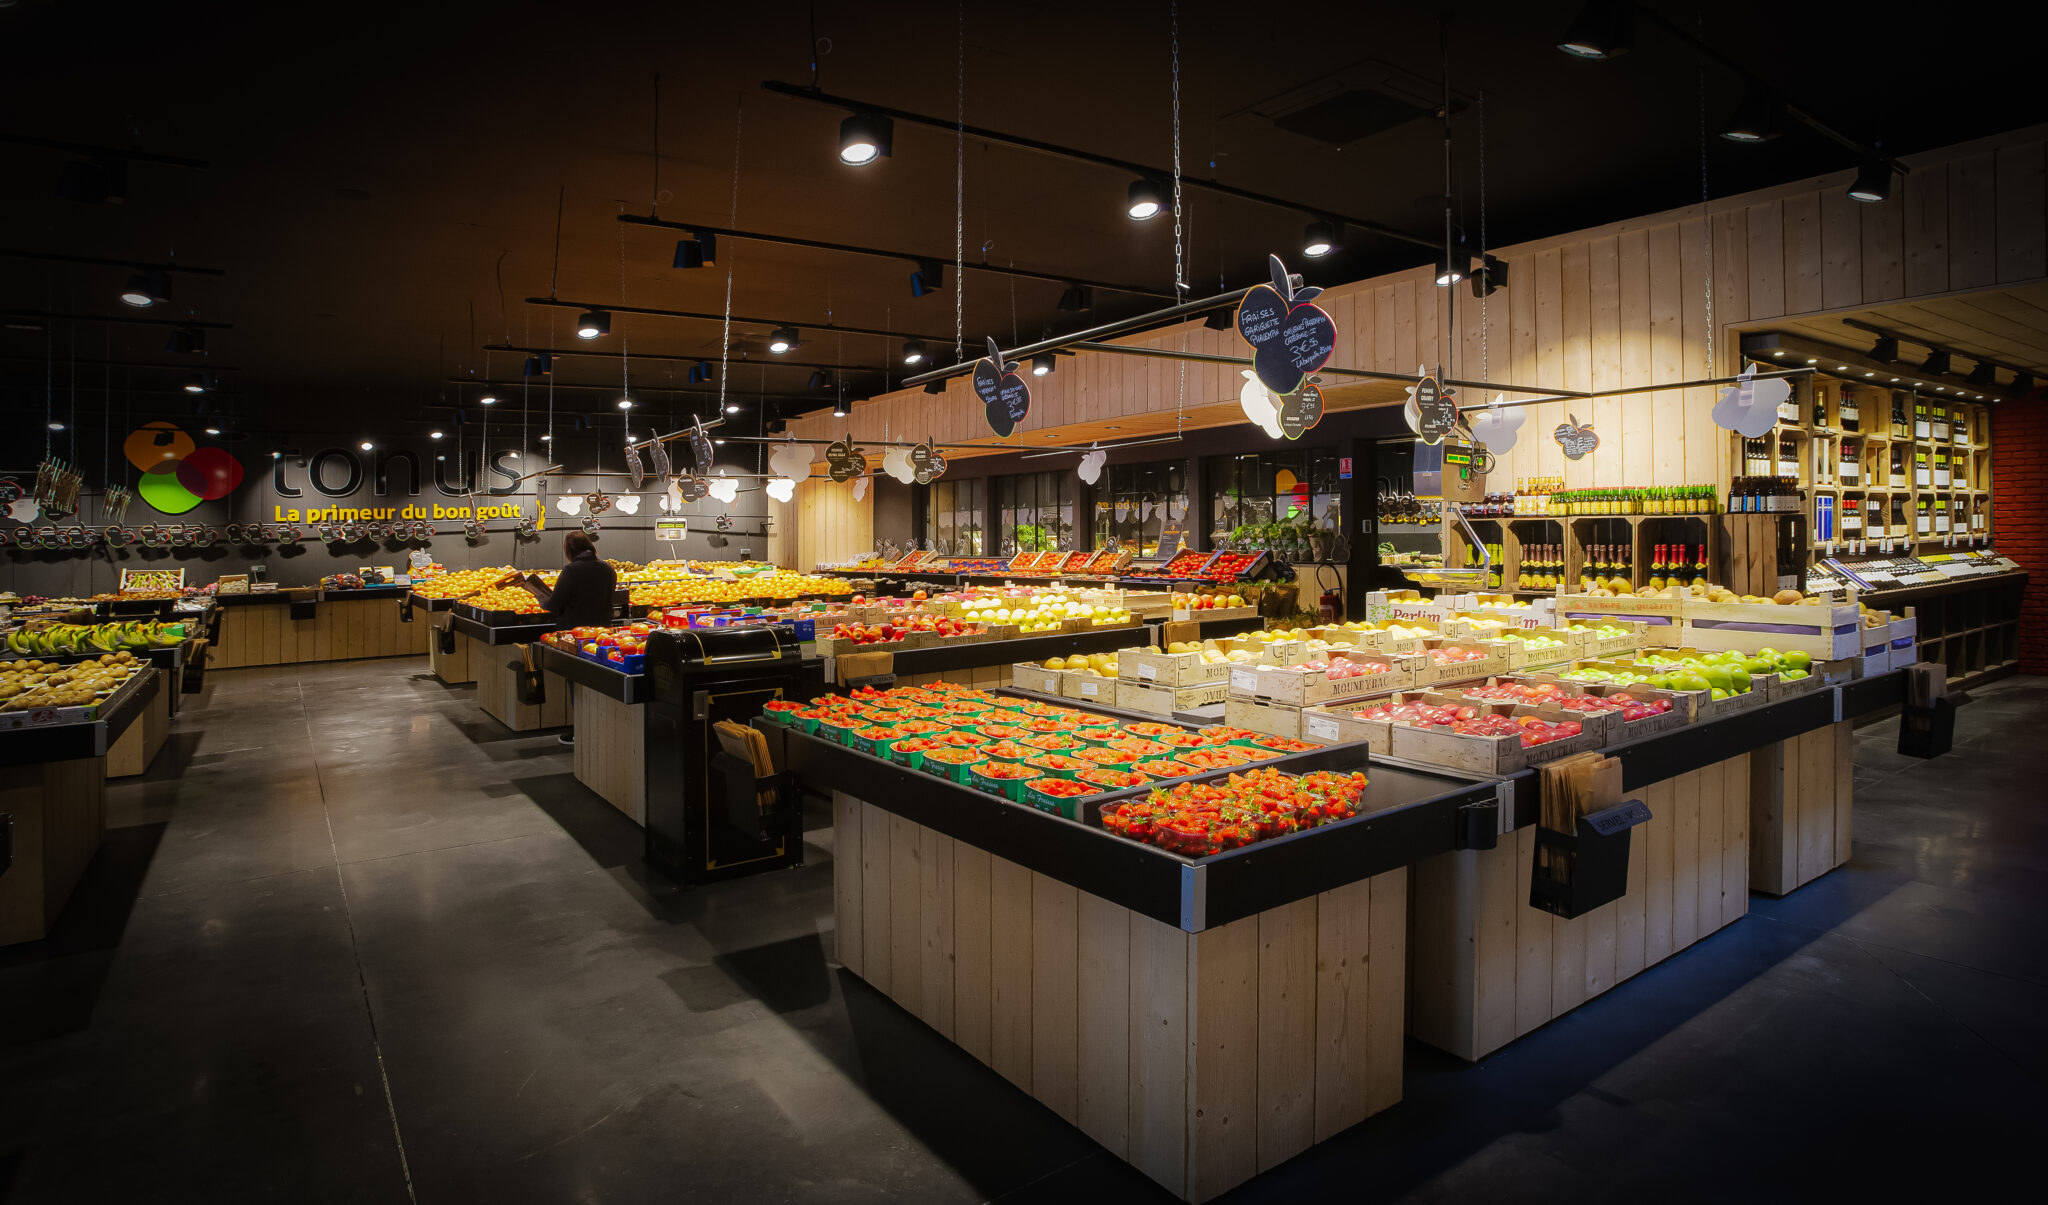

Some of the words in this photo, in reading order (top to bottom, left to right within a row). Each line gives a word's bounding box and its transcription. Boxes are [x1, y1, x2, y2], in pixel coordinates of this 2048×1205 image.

[268, 447, 523, 498] tonus
[275, 505, 300, 522] La
[306, 504, 396, 524] primeur
[401, 503, 426, 520] du
[433, 503, 471, 520] bon
[476, 503, 521, 523] goût
[1393, 608, 1441, 622] Perlim
[1332, 675, 1389, 695] MOUNEYRAC
